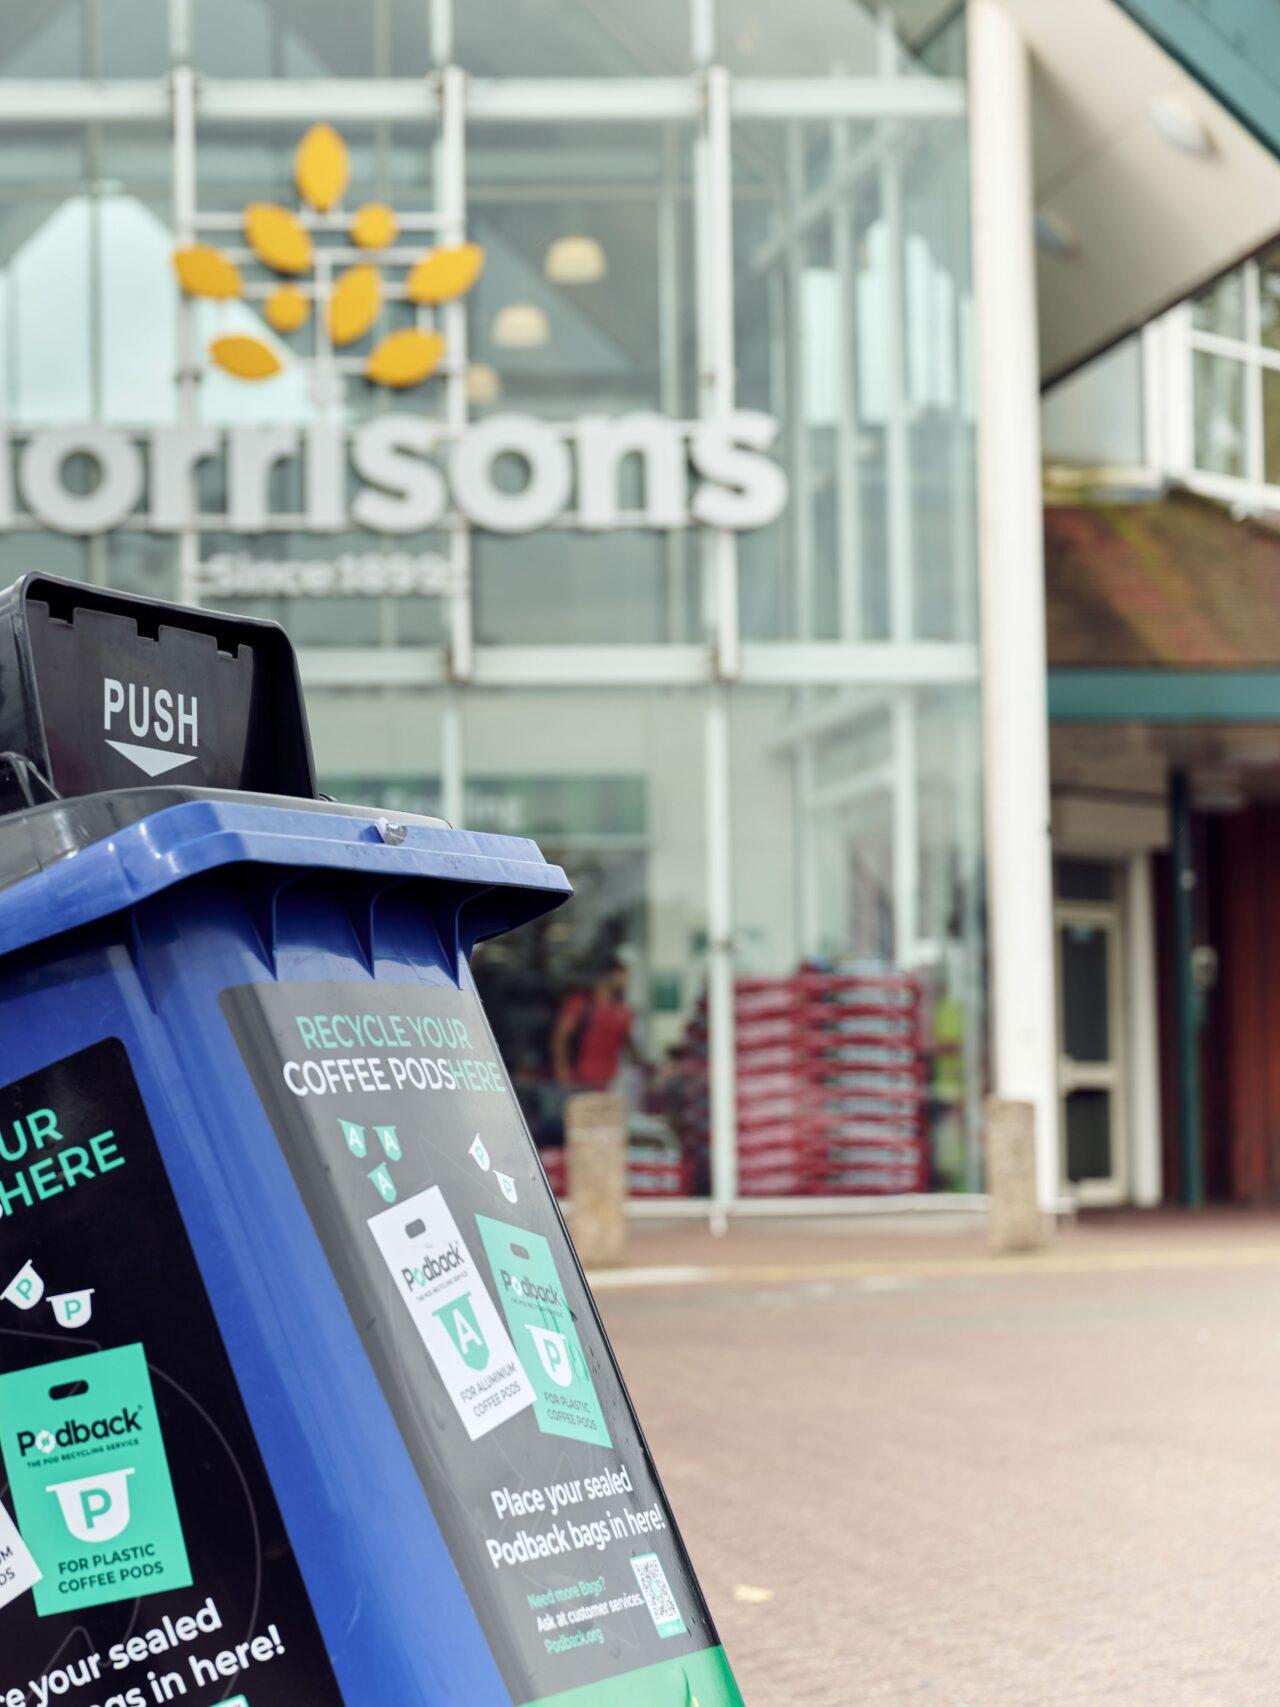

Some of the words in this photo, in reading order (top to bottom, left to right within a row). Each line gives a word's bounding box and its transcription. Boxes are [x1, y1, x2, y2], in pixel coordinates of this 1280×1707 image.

[104, 678, 197, 747] PUSH
[295, 1015, 412, 1050] RECYCLE
[407, 1016, 473, 1049] YOUR
[283, 1057, 391, 1096] COFFEE
[401, 1243, 464, 1292] Podback
[452, 1309, 482, 1354] A
[473, 1392, 502, 1417] COFFEE
[17, 1407, 142, 1456] Podback
[80, 1488, 112, 1529] P
[491, 1487, 545, 1520] Place
[545, 1479, 583, 1515] your
[584, 1464, 633, 1500] sealed
[486, 1523, 571, 1569] Podback
[567, 1520, 611, 1550] bags
[606, 1510, 628, 1540] in
[624, 1503, 666, 1535] here!
[58, 1557, 89, 1575] FOR
[92, 1543, 156, 1567] PLASTIC
[58, 1571, 116, 1594] COFFEE
[120, 1561, 164, 1582] PODS
[527, 1589, 555, 1609] Need
[555, 1585, 580, 1602] more
[537, 1613, 557, 1632] Ask
[556, 1611, 568, 1627] at
[567, 1602, 609, 1624] customer
[28, 1653, 100, 1707] your
[108, 1597, 223, 1670] sealed
[544, 1628, 605, 1655] Podback.org
[147, 1671, 187, 1704] in
[188, 1624, 285, 1683] here!
